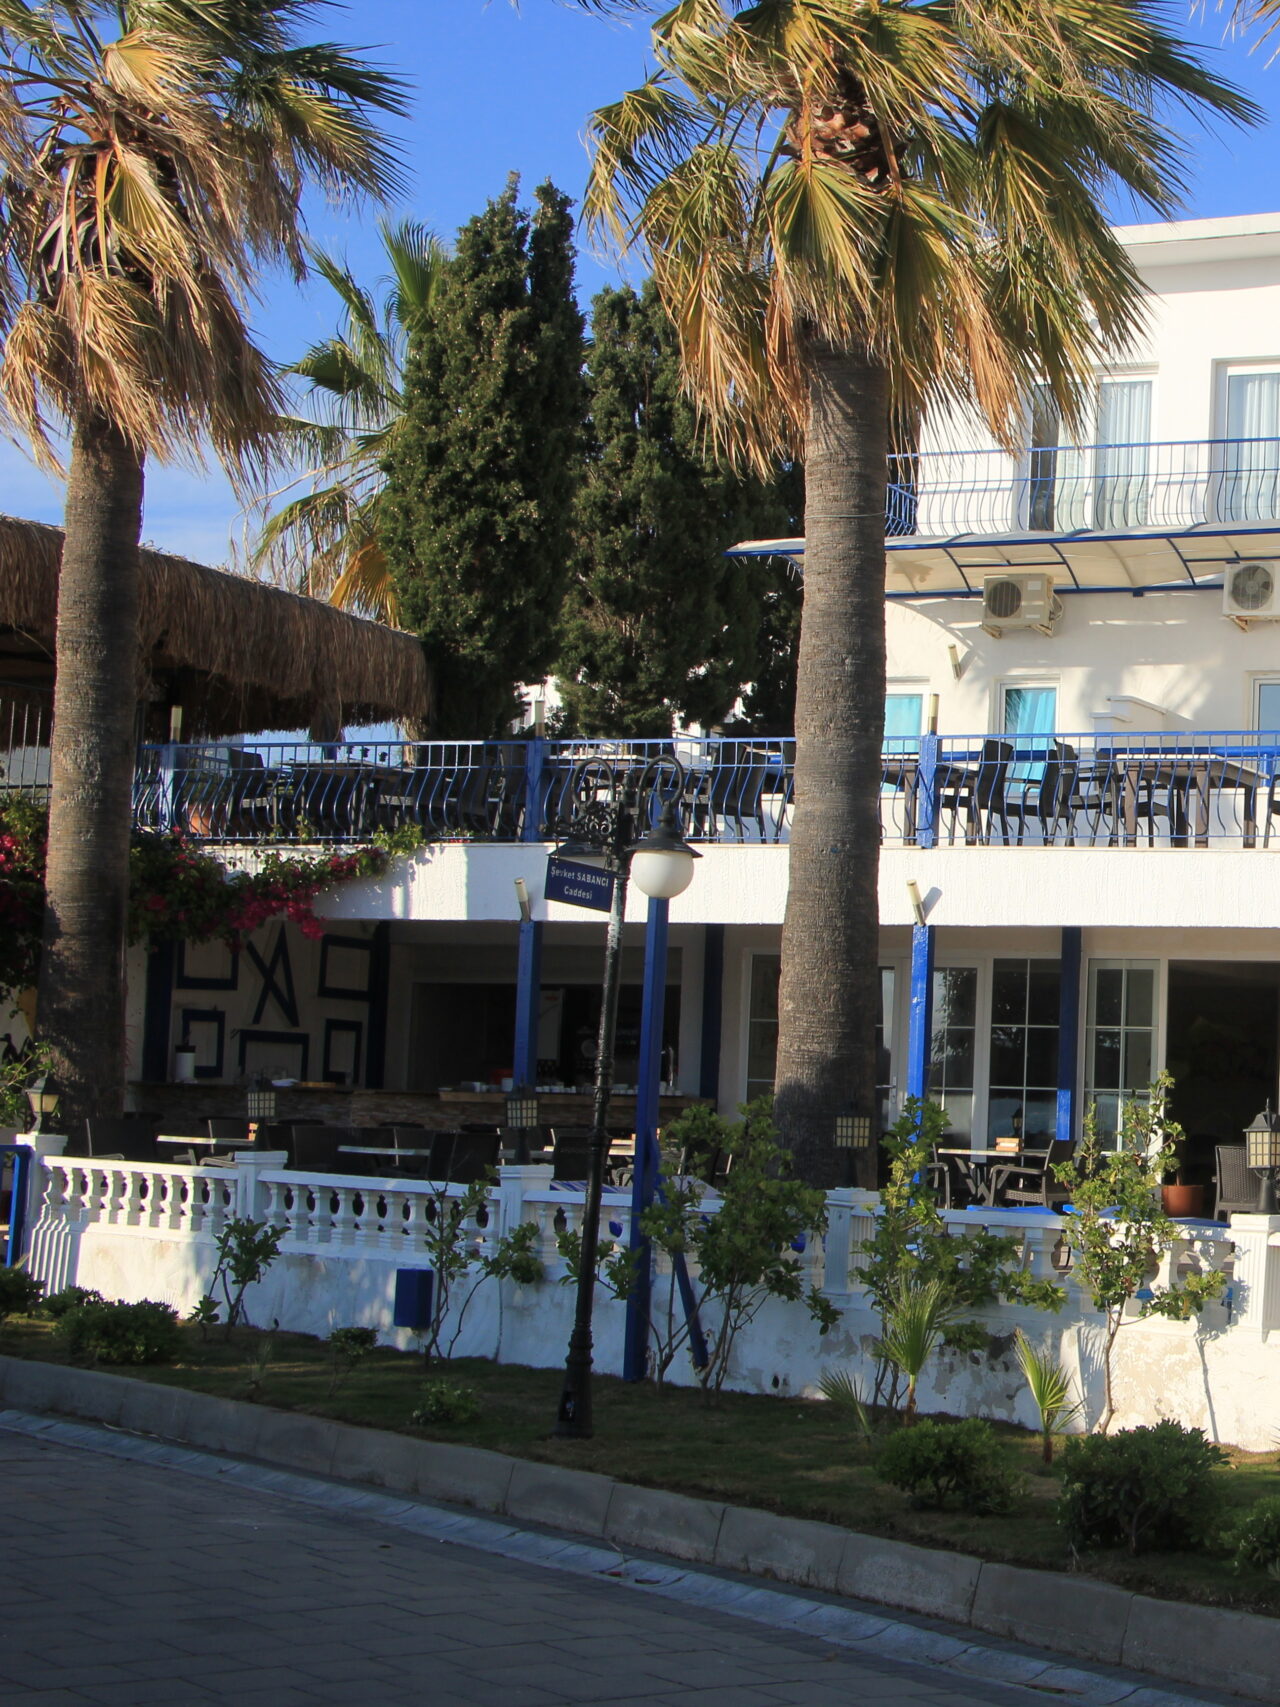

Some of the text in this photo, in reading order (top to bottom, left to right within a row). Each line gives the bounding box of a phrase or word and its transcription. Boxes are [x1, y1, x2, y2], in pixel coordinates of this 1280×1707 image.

[551, 866, 609, 887] Şevket SABANCI
[563, 886, 593, 900] Caddesi
